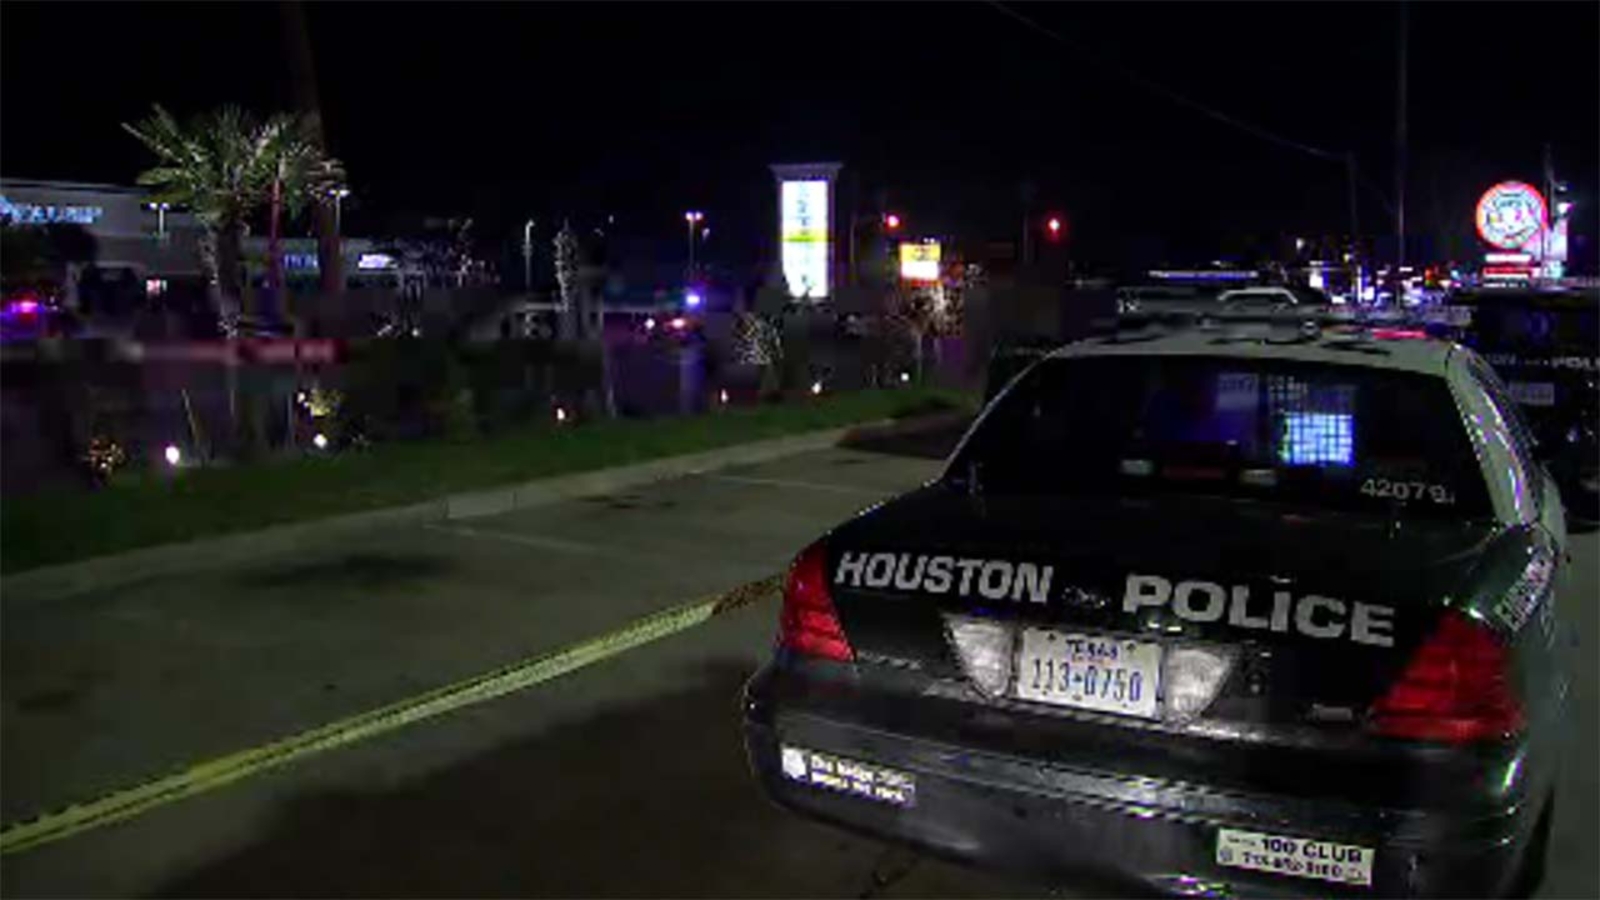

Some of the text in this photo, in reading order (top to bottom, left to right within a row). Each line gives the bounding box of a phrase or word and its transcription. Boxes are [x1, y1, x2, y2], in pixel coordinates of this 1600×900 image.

[834, 550, 1396, 647] HOUSTON POLICE
[1260, 838, 1298, 856] 100
[1302, 840, 1363, 864] CLUB
